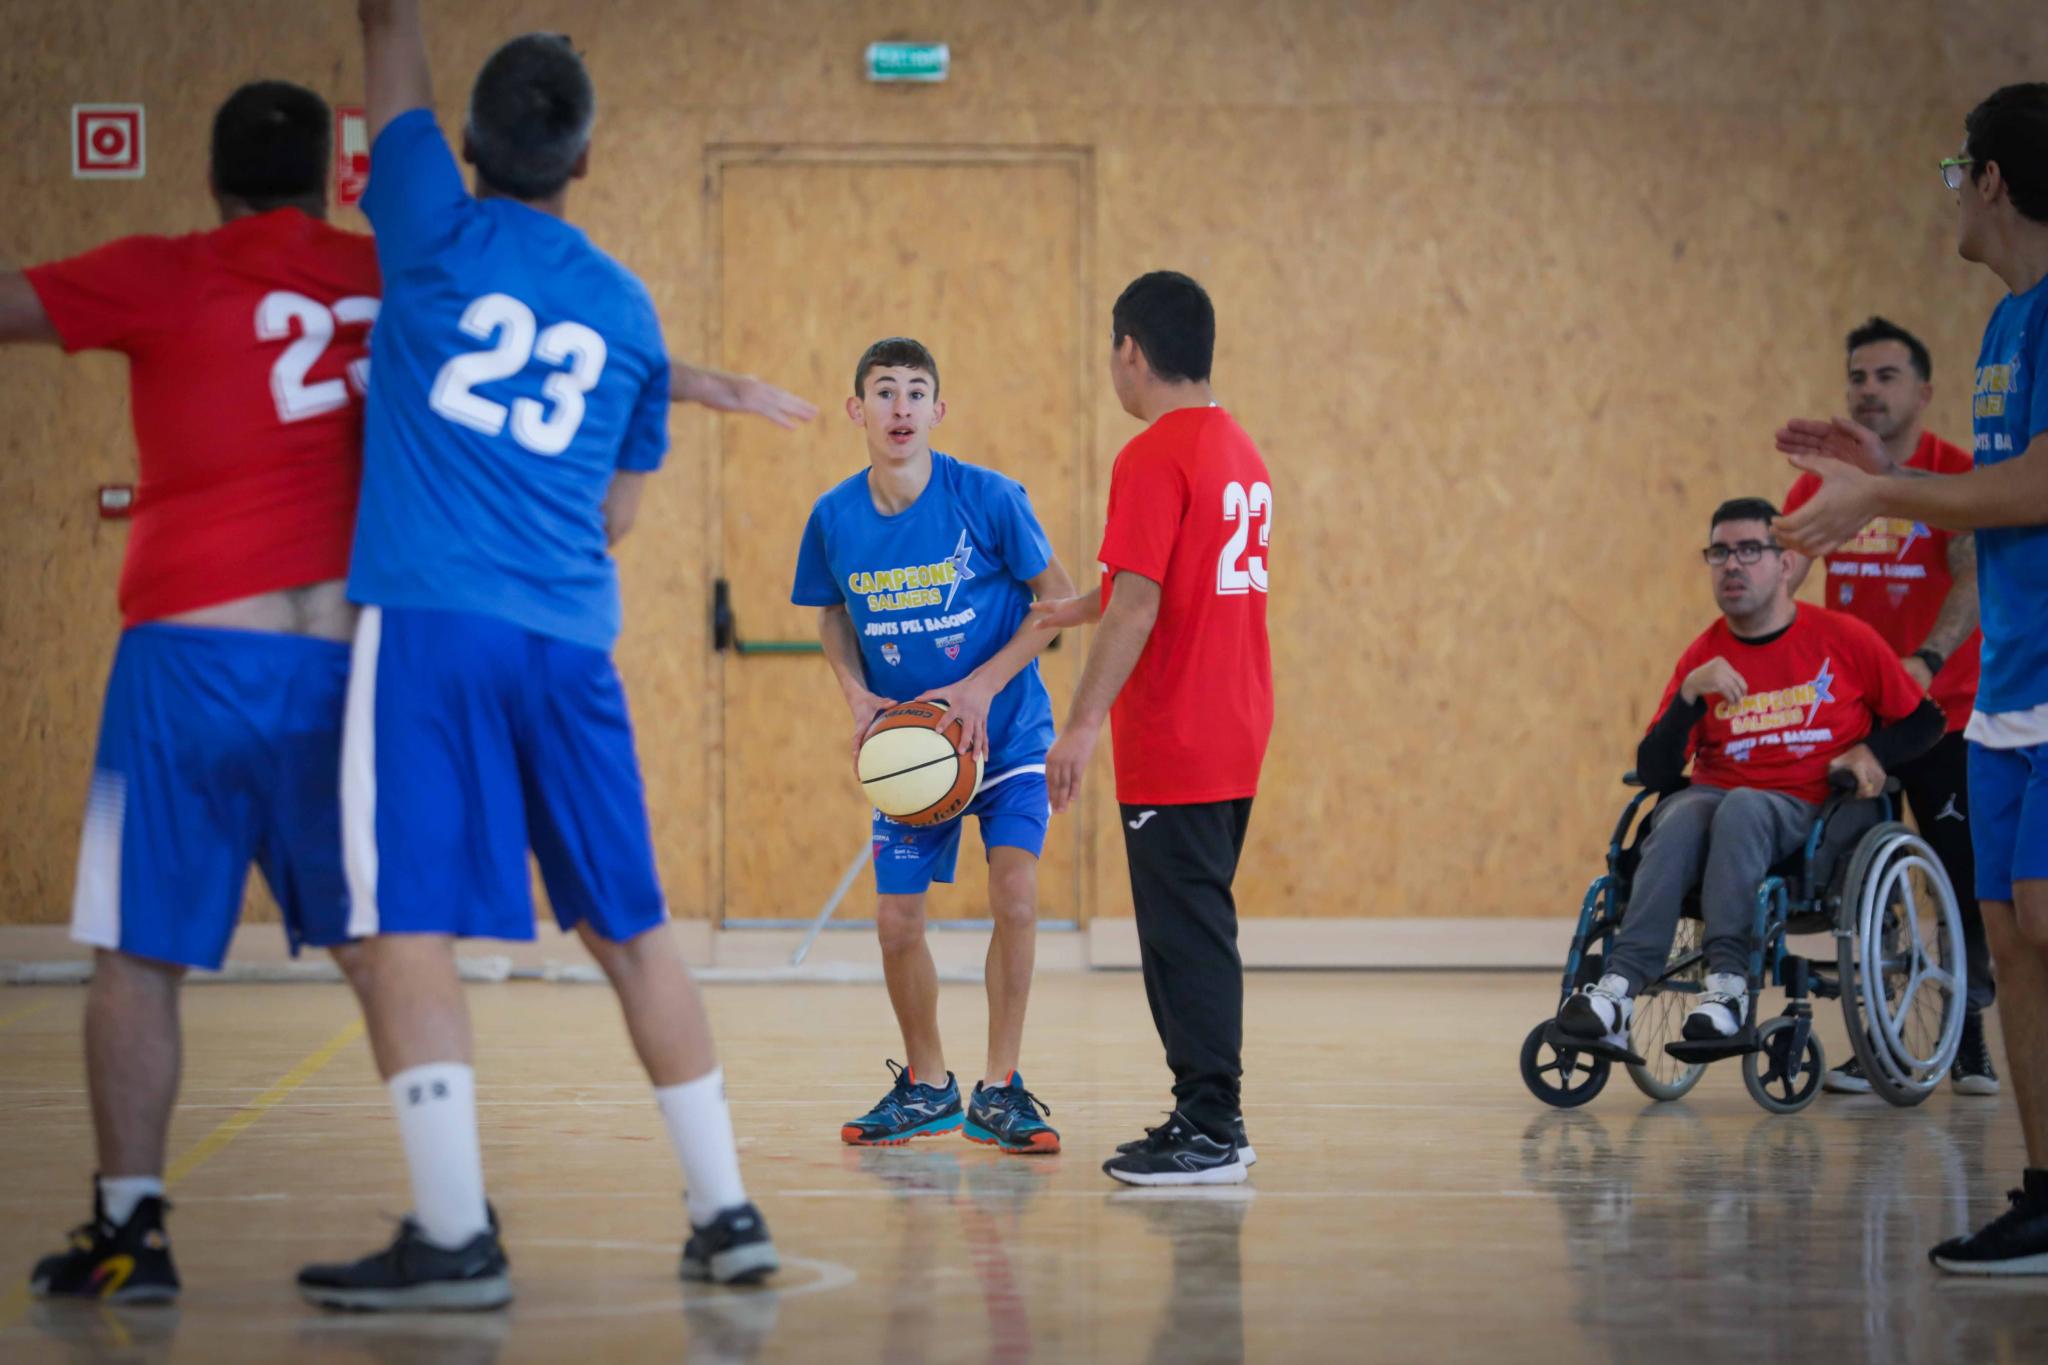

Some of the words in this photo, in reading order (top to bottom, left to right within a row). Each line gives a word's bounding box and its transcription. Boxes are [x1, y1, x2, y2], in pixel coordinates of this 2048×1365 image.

[428, 292, 607, 456] 23
[1216, 481, 1272, 595] 23
[864, 621, 899, 637] JUNTS
[901, 618, 924, 635] PEL
[867, 588, 943, 612] SALINERS
